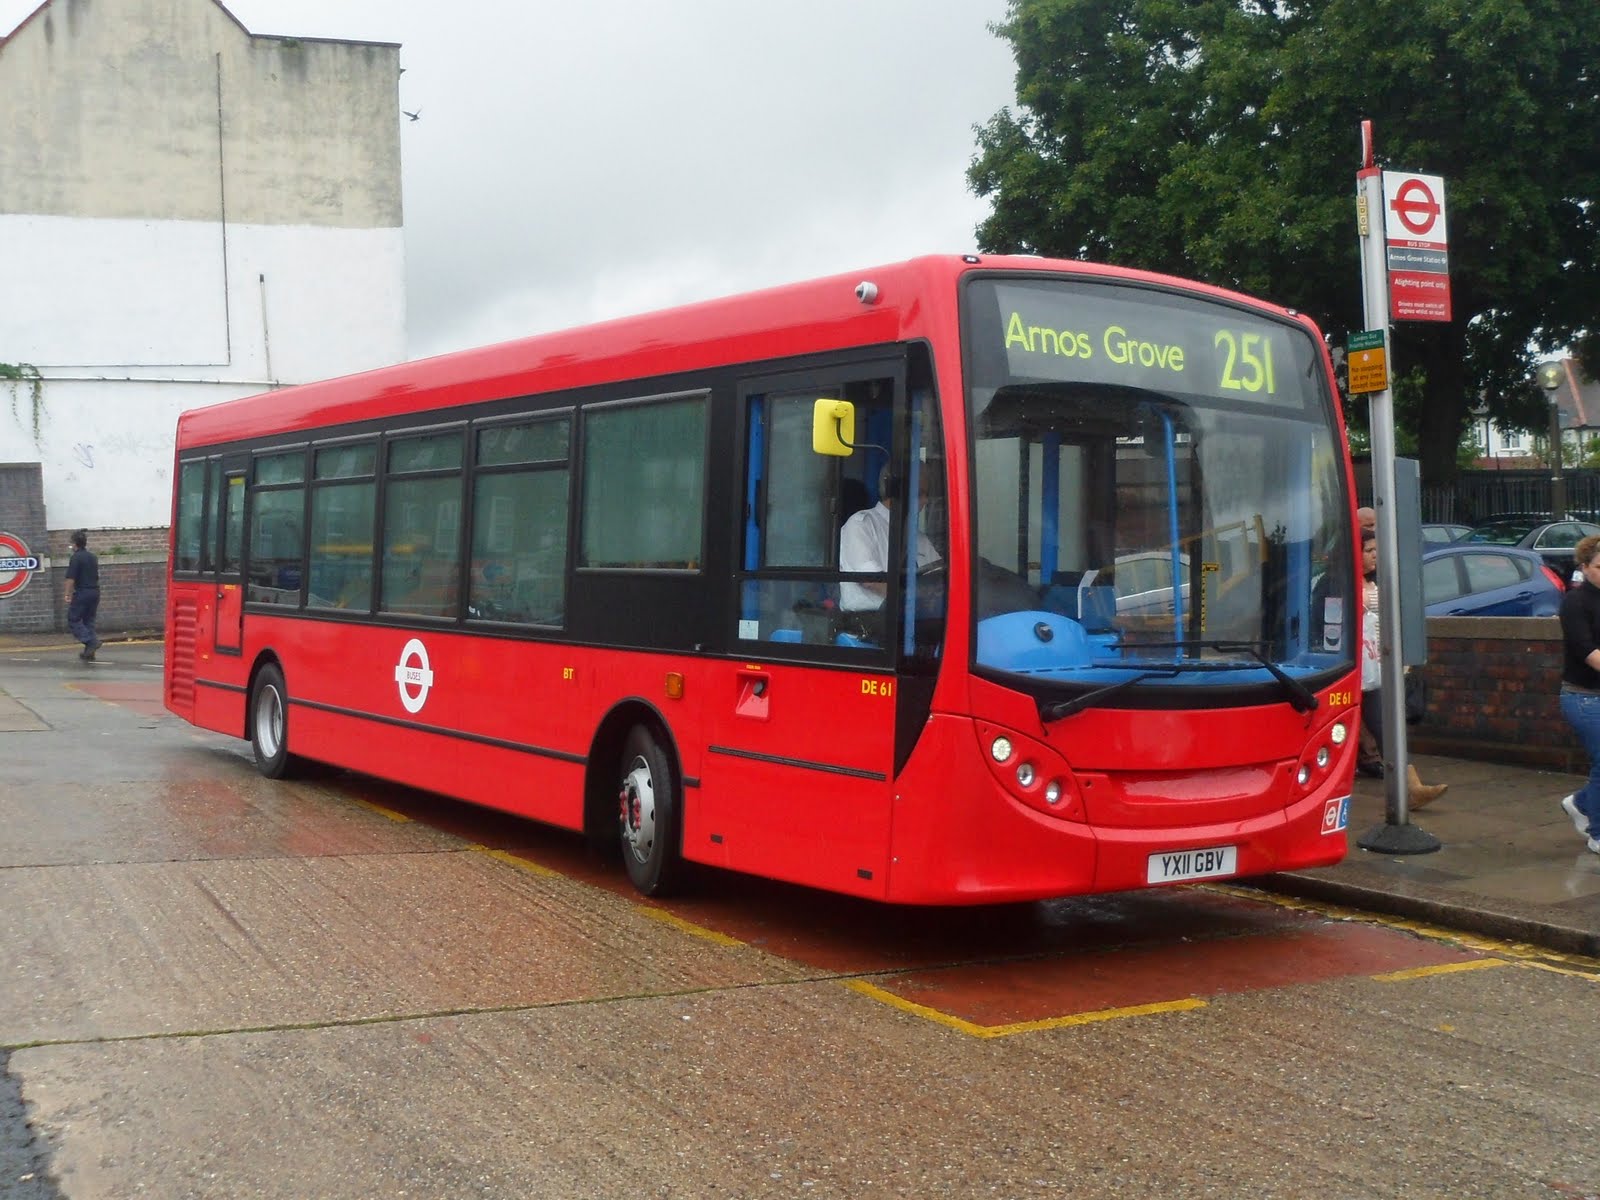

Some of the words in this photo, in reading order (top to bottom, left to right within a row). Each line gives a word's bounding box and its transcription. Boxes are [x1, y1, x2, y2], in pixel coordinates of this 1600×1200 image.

[1423, 256, 1441, 264] Station
[1394, 278, 1420, 288] Alighting
[1435, 282, 1446, 290] only
[1005, 312, 1092, 359] Arnos
[1104, 326, 1184, 371] Grove
[1214, 329, 1275, 394] 251
[406, 671, 421, 680] BUSES
[563, 668, 574, 680] BT
[861, 679, 878, 695] DE
[880, 681, 892, 697] 61
[1329, 692, 1342, 706] DE
[1342, 691, 1351, 705] 61
[1162, 854, 1191, 876] YX11
[1194, 850, 1225, 873] GBV
